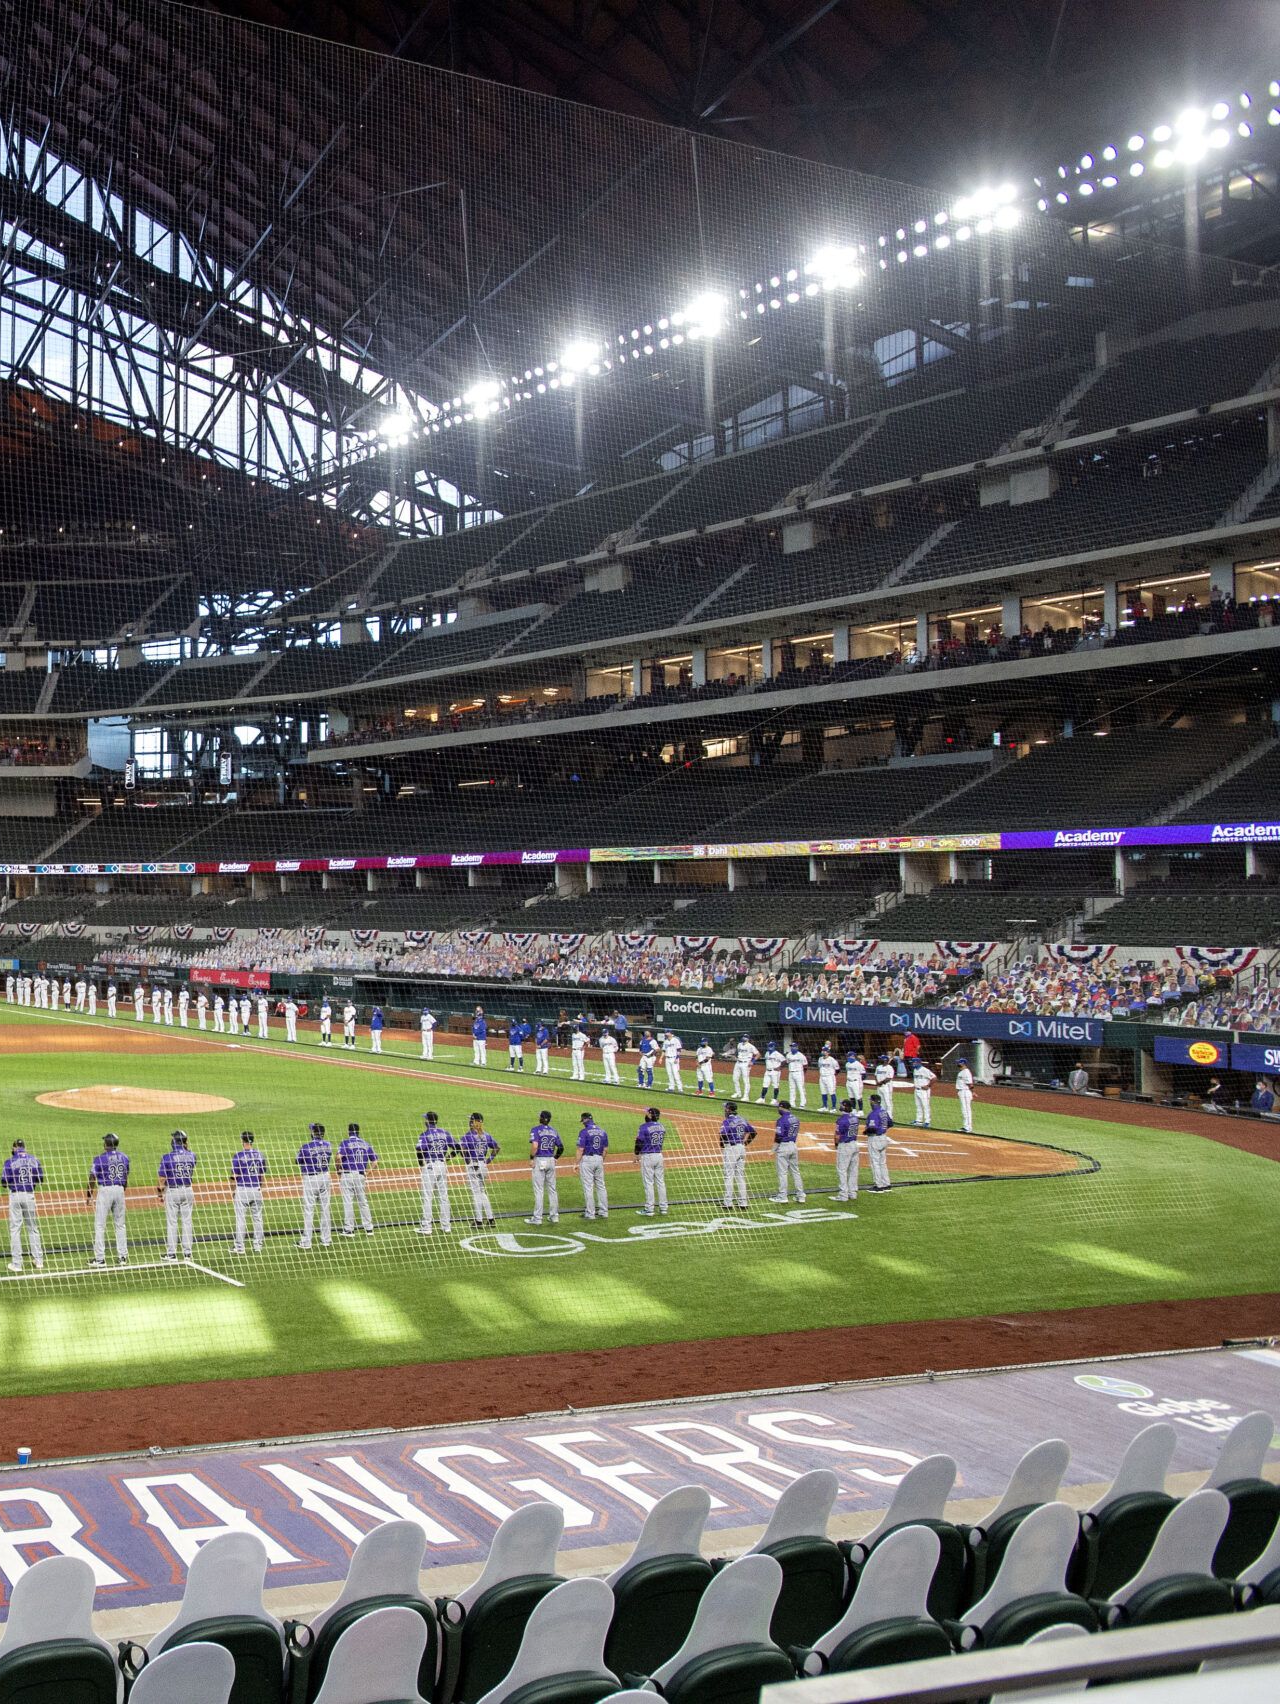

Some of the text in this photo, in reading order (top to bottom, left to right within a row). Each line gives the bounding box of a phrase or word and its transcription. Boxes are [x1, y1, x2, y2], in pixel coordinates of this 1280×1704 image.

[125, 763, 133, 783] TRULY
[1054, 830, 1122, 845] Academy
[522, 851, 559, 861] Academy
[694, 846, 728, 856] 26 Dahl
[219, 862, 251, 871] Academy
[275, 861, 301, 870] Academy
[328, 859, 357, 868] Academy
[387, 856, 418, 866] Academy
[451, 854, 485, 864] Academy
[663, 1000, 757, 1018] RoofClaim.com
[806, 1006, 848, 1024] Mitel
[914, 1012, 962, 1032] Mitel
[1037, 1021, 1092, 1041] Mitel
[592, 1135, 601, 1150] 9
[108, 1163, 126, 1181] 39
[175, 1162, 193, 1178] 53
[569, 1208, 859, 1243] LEXUS
[1117, 1398, 1231, 1417] Globe
